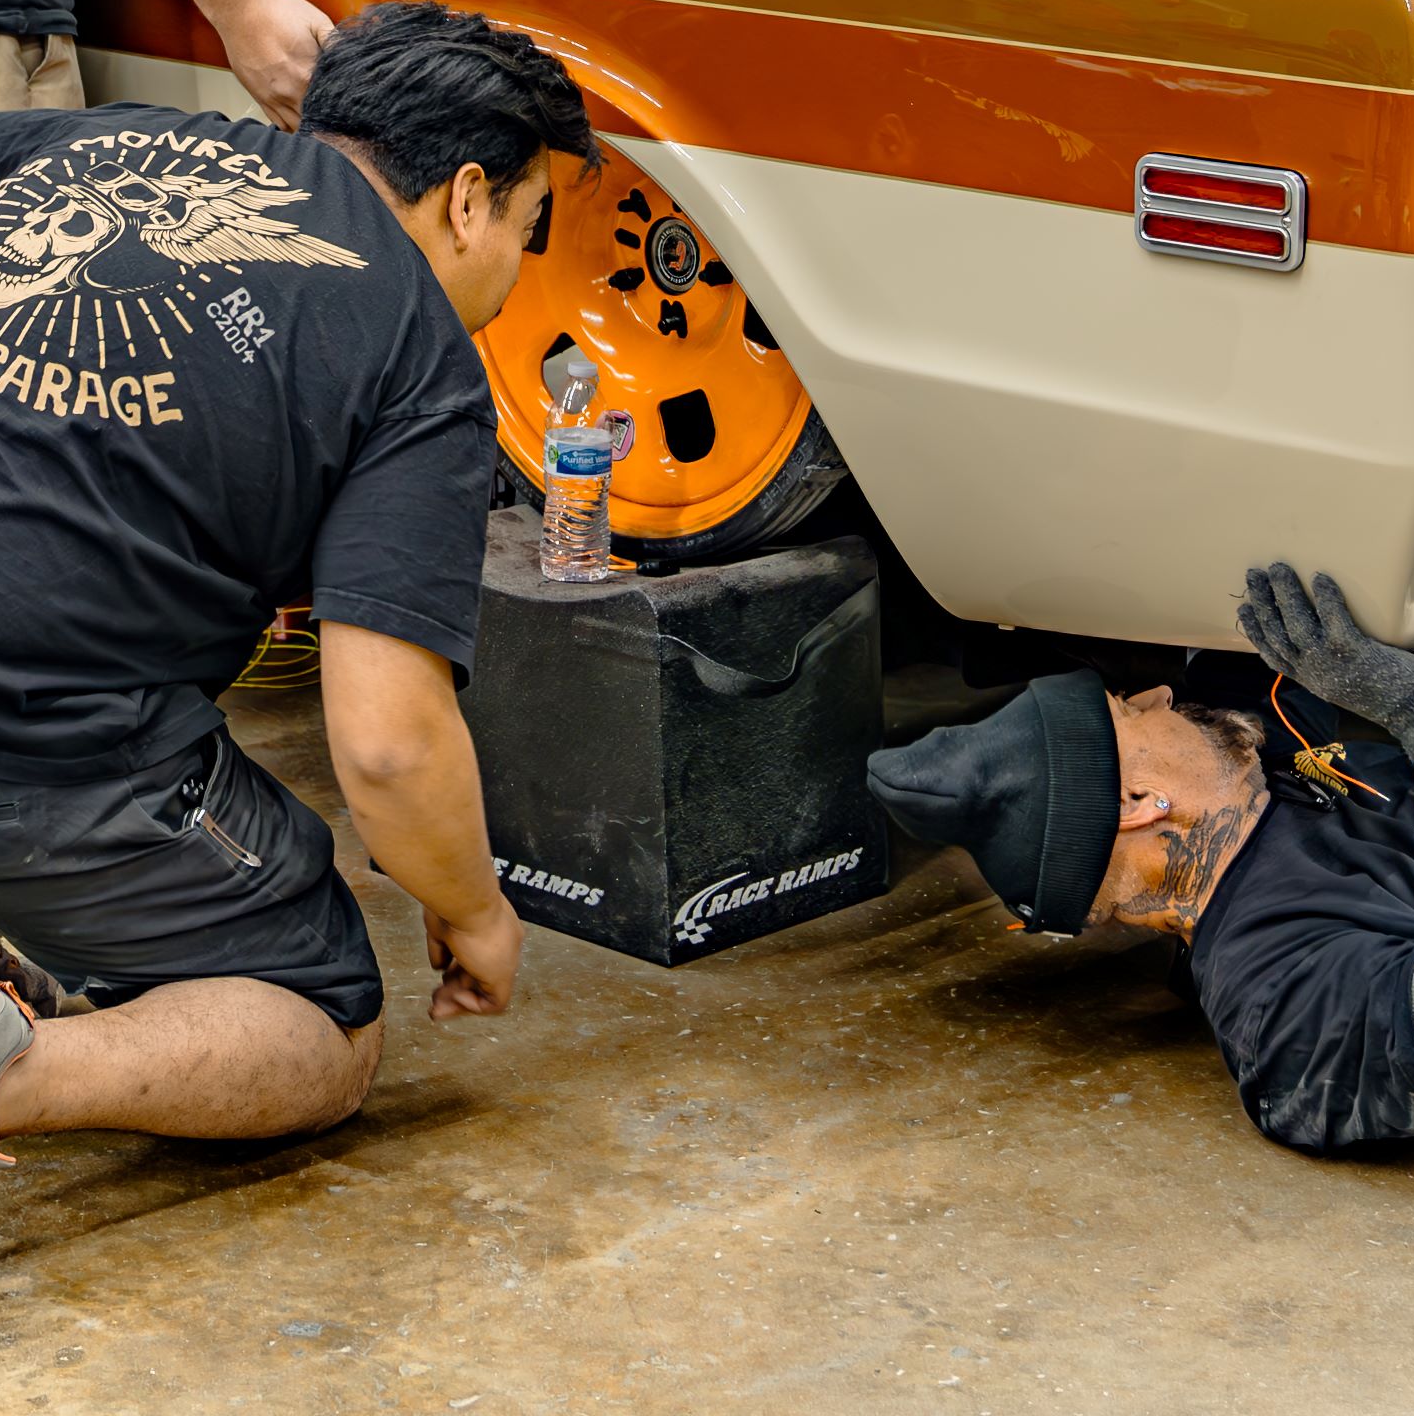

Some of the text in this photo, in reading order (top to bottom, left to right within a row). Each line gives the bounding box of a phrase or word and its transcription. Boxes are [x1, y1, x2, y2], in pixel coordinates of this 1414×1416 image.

[69, 130, 290, 187] MONKEY
[221, 286, 276, 350] RR1
[562, 454, 595, 465] Purified
[509, 863, 605, 907] RAMPS
[706, 847, 864, 919] RACE RAMPS
